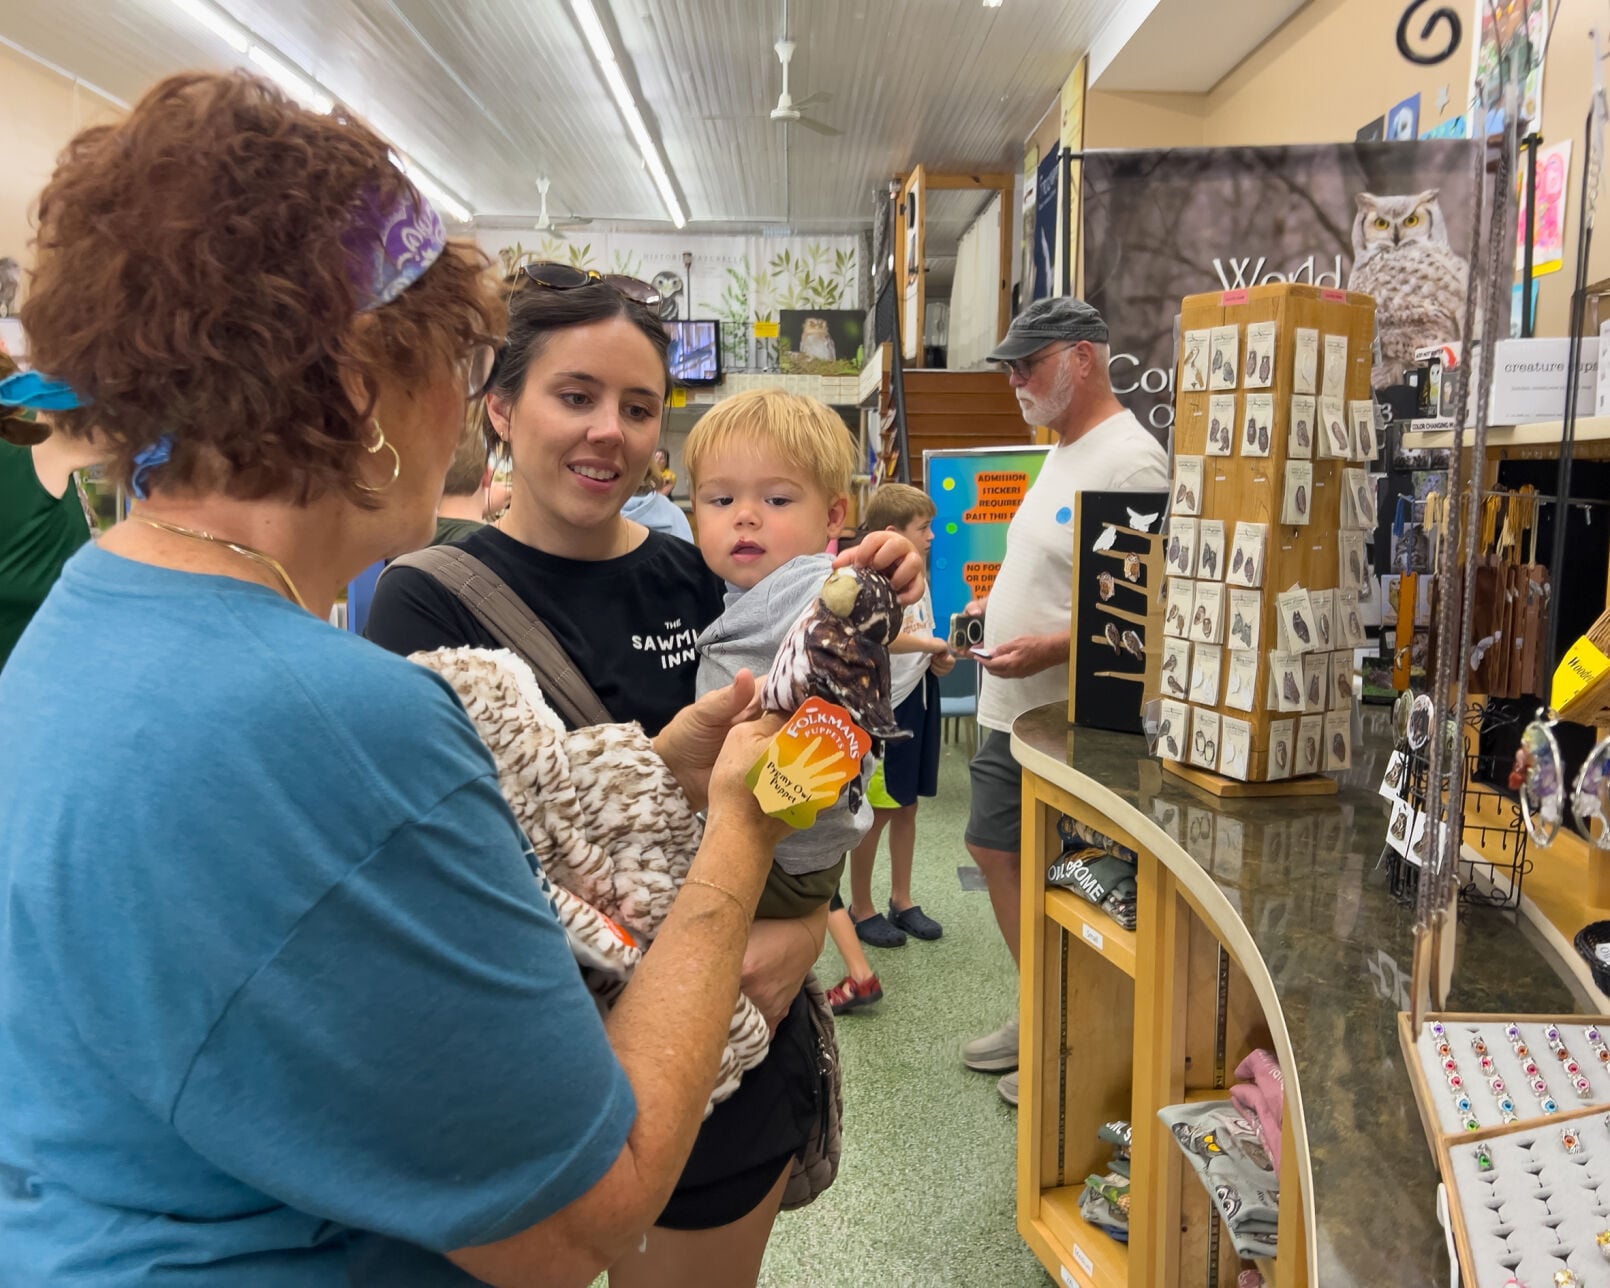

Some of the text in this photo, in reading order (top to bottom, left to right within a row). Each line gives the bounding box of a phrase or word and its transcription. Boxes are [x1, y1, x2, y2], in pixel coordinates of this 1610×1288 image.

[1212, 254, 1342, 291] World
[1504, 361, 1565, 374] creature
[978, 474, 1026, 482] ADMISSION
[982, 487, 1021, 495] STICKERS
[966, 512, 987, 520] PAST
[990, 512, 1008, 520] THIS
[664, 618, 681, 630] THE
[632, 629, 698, 651] SAWMI
[661, 648, 696, 669] INN
[787, 713, 859, 759] FOLKMANIS
[804, 726, 845, 749] PUPPETS
[767, 761, 813, 802] Pygmy Owl
[770, 776, 796, 803] Puppet
